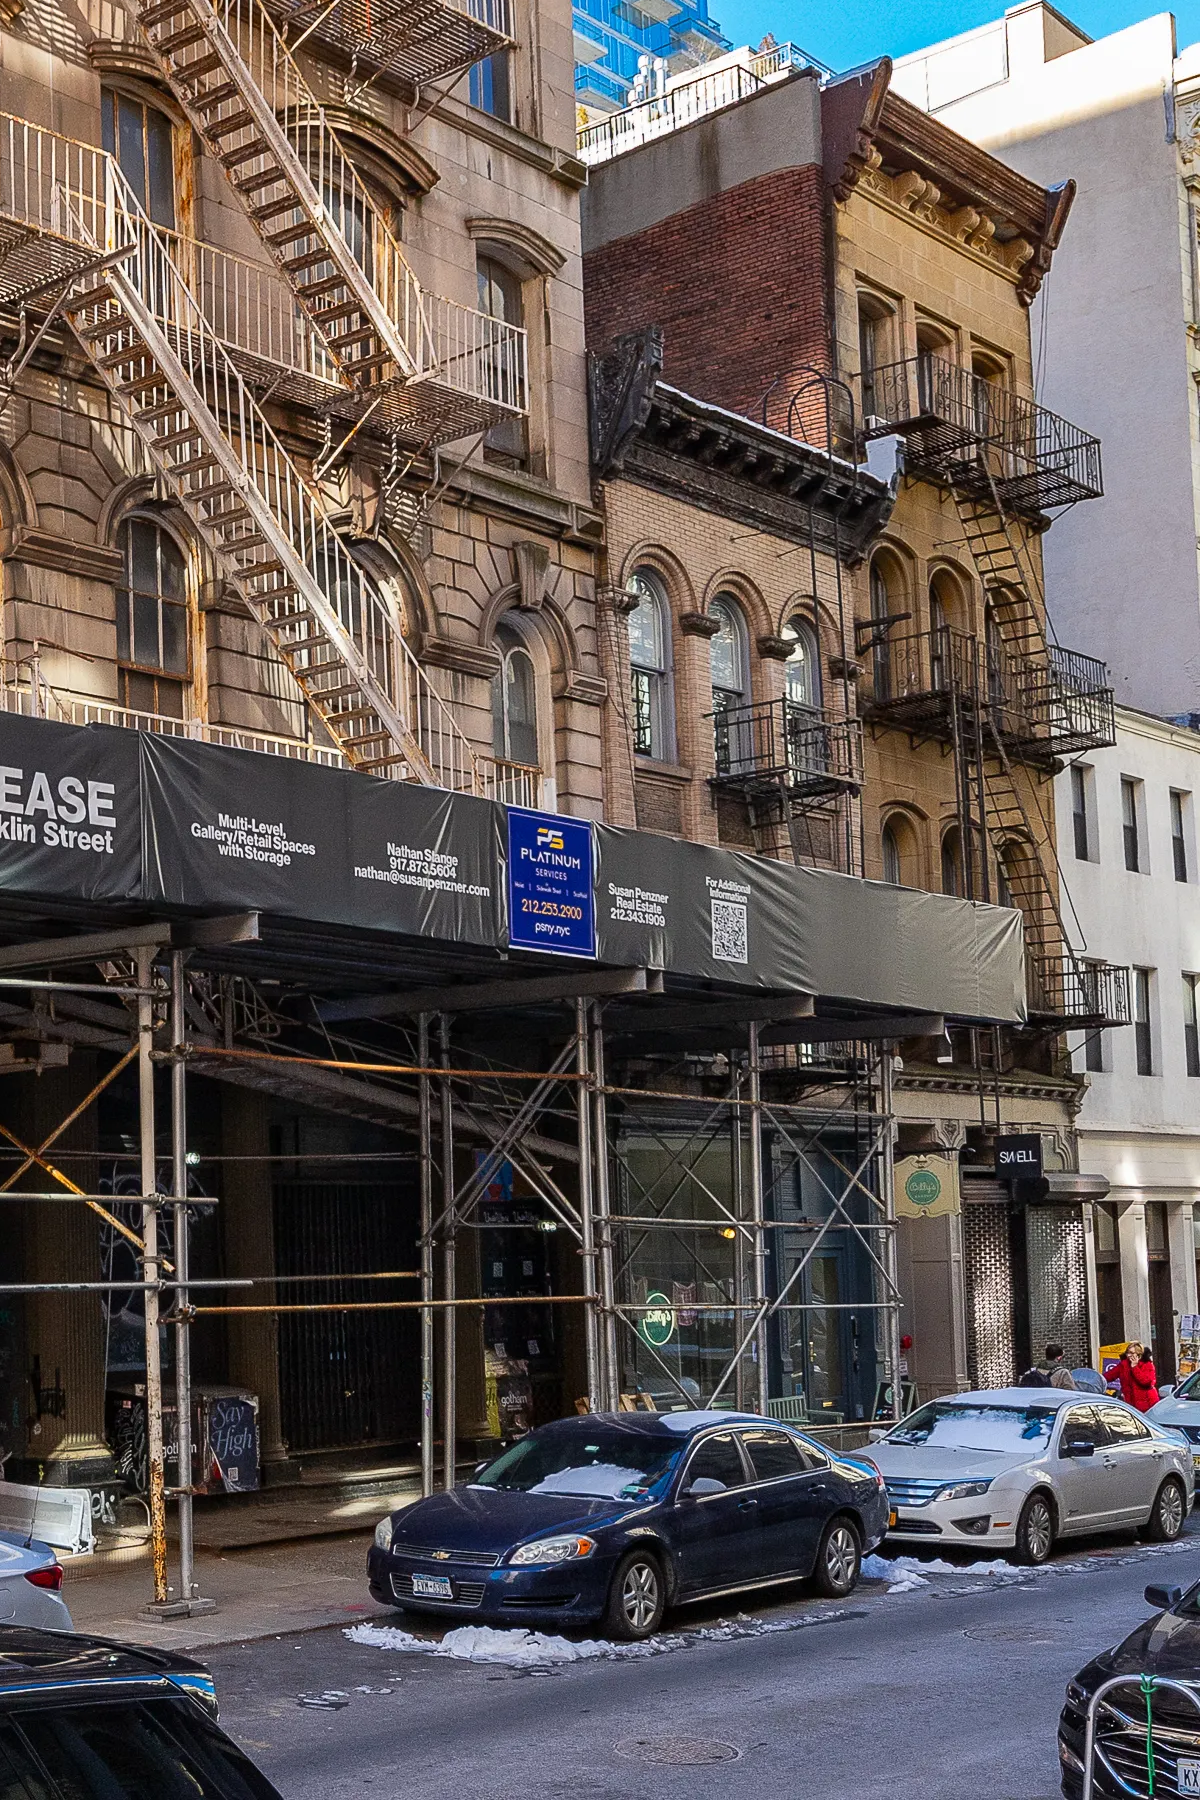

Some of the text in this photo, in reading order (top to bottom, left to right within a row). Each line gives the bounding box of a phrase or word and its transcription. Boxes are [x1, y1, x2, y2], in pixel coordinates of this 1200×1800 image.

[218, 813, 286, 839] Multi-Level,
[43, 821, 114, 854] Street
[191, 822, 316, 856] Gallery/Retail Spaces
[218, 843, 291, 867] with Storage
[386, 842, 424, 861] Nathan
[520, 847, 581, 870] PLATINUM
[354, 865, 490, 897] nathan@susanpenzner.com
[535, 867, 568, 881] SERVICES
[608, 882, 669, 905] Susan Penzner
[705, 876, 751, 895] For Additional
[616, 897, 662, 915] Real Estate
[709, 890, 748, 904] Information
[521, 898, 583, 920] 212.253.2900
[610, 908, 666, 927] 212.343.1909
[535, 921, 571, 937] psny.nyc
[999, 1150, 1037, 1164] SWELL
[211, 1401, 245, 1429] Say
[211, 1425, 252, 1460] High
